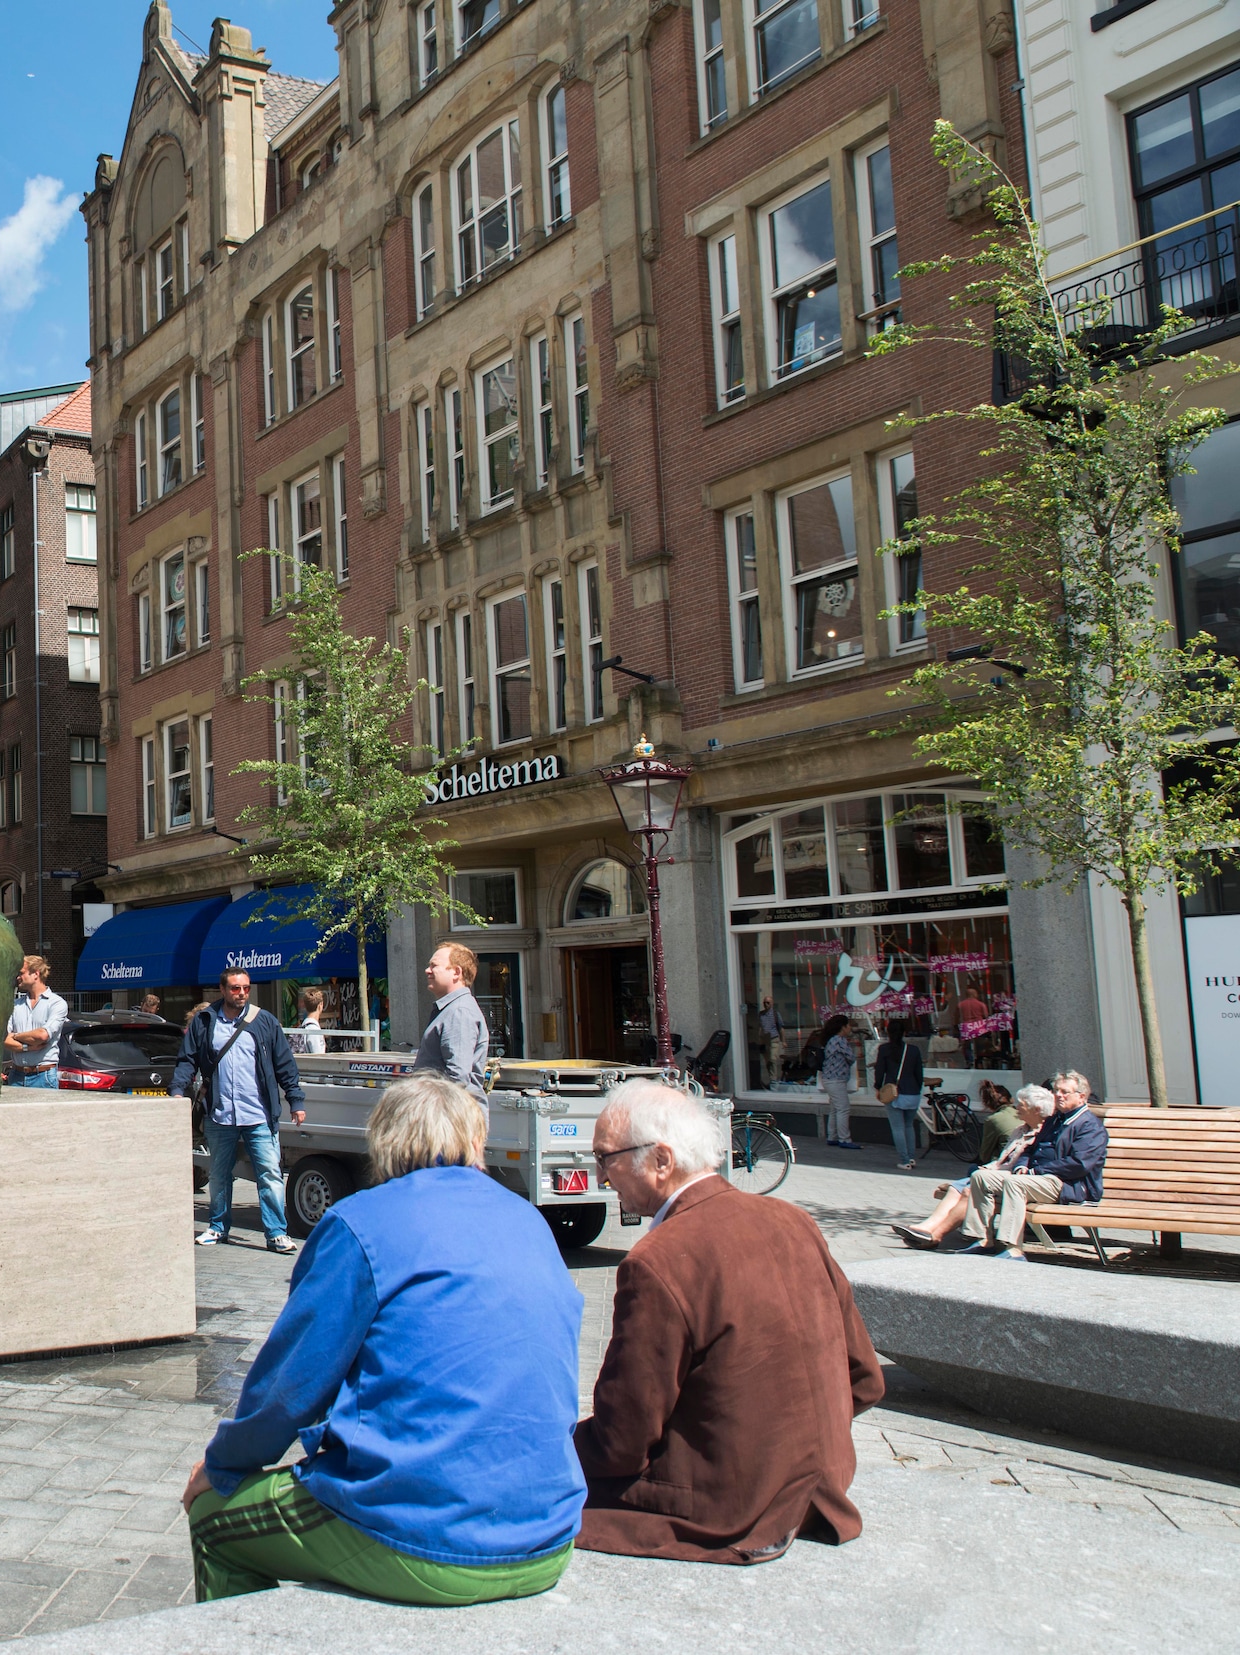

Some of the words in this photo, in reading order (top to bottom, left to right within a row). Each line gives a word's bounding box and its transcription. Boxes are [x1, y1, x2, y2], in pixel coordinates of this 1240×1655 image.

[424, 754, 561, 806] Scheltema
[226, 949, 282, 970] Scheltema
[965, 959, 988, 971] SALE
[101, 962, 143, 980] Scheltema
[1227, 993, 1240, 1003] C
[351, 1063, 392, 1072] INSTANT
[550, 1124, 575, 1135] saris
